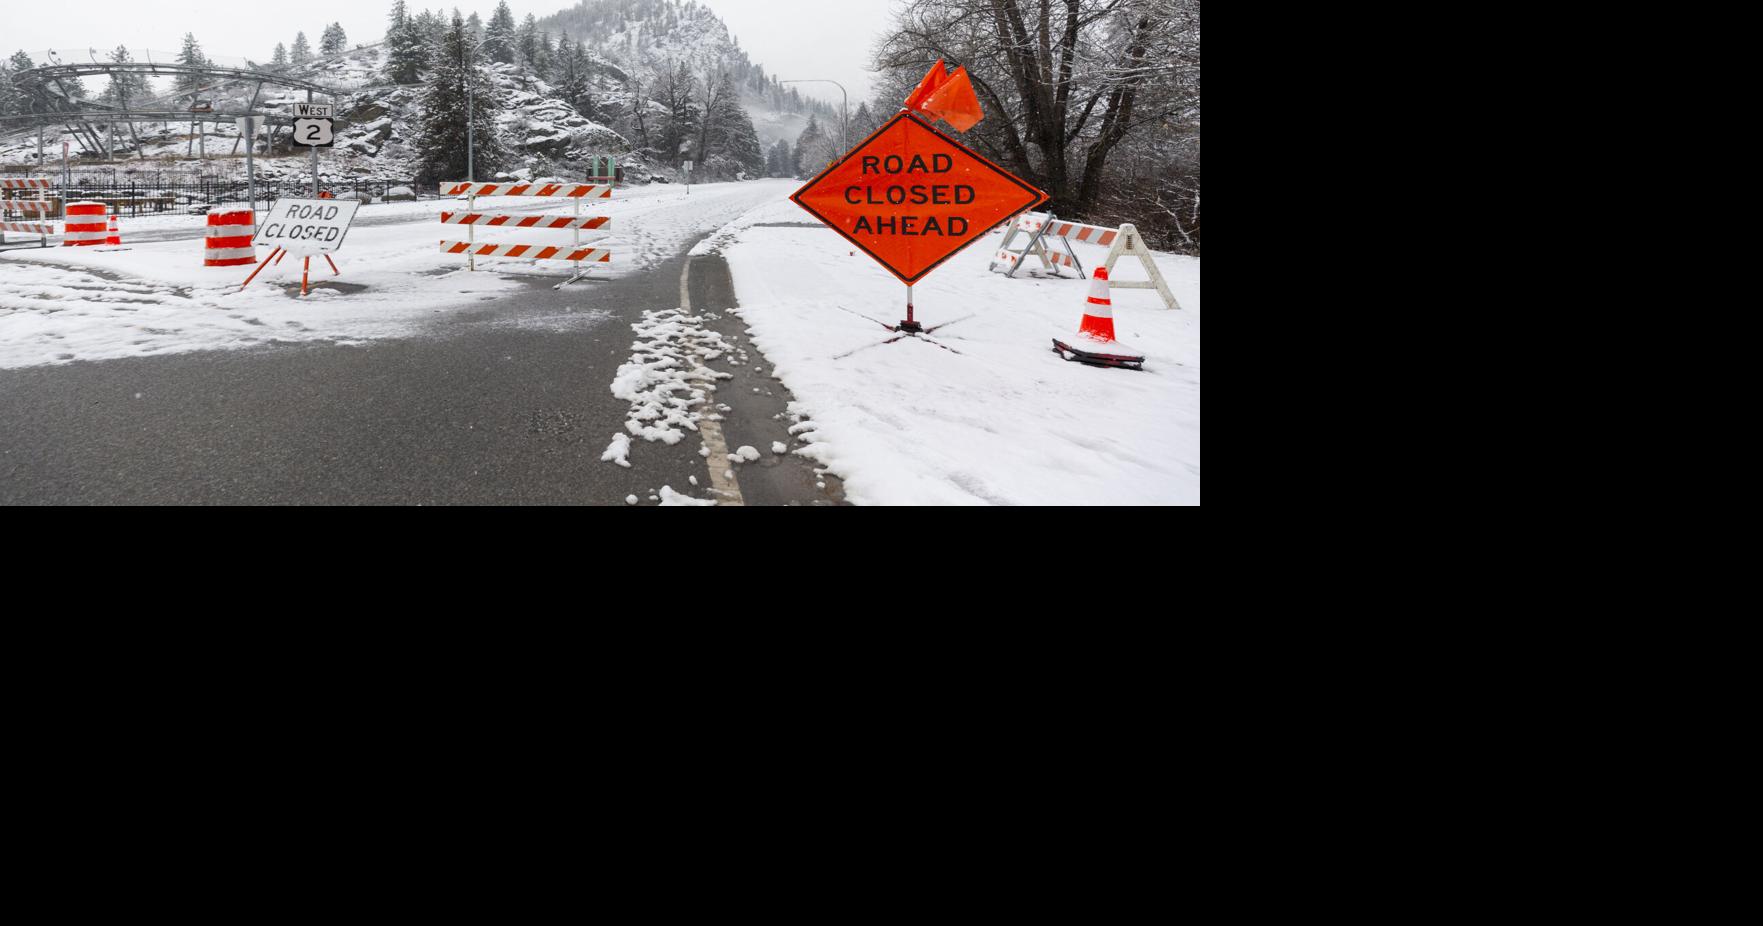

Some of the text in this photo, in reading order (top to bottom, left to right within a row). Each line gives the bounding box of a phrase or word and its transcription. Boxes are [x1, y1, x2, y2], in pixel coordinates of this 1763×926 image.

[298, 104, 328, 116] WEST
[306, 124, 321, 141] 2
[862, 153, 953, 175] ROAD
[844, 185, 976, 205] CLOSED
[286, 204, 339, 221] ROAD
[265, 223, 340, 242] CLOSED
[852, 215, 969, 237] AHEAD
